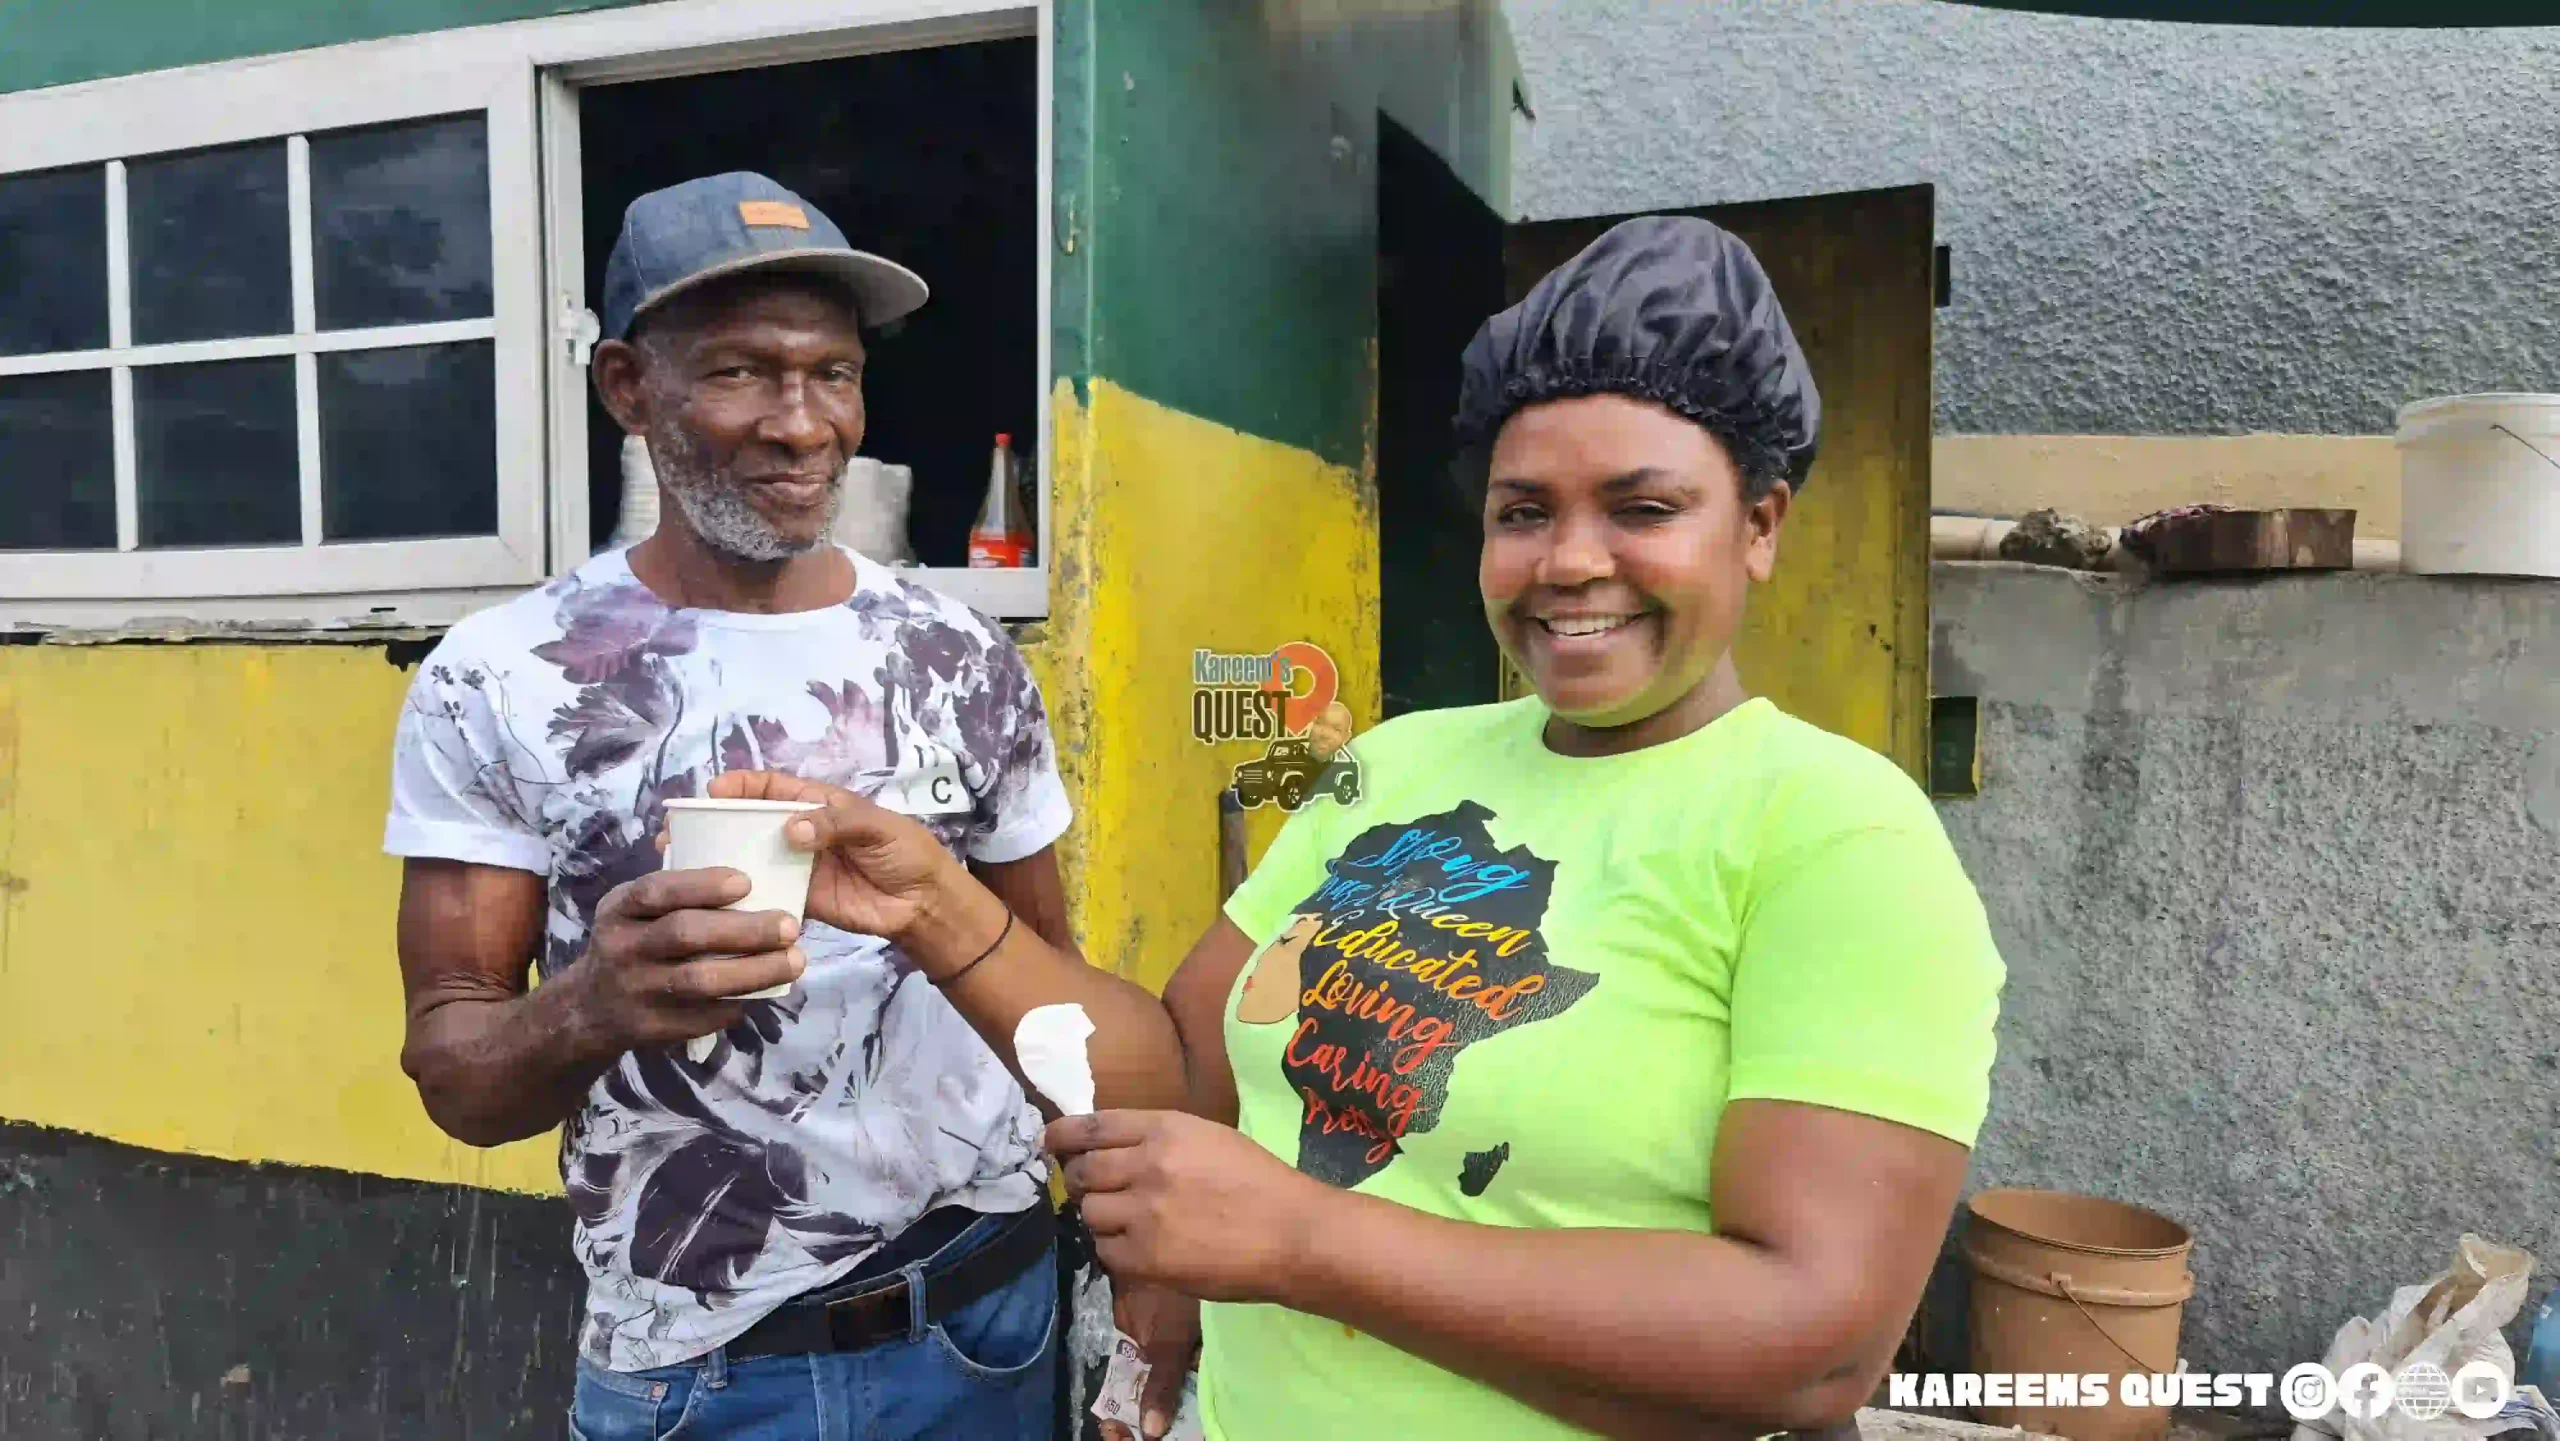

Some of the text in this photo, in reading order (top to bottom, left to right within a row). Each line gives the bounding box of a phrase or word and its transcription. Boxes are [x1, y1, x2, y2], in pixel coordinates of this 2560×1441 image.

[1347, 828, 1531, 902] Strong
[1312, 908, 1546, 1021] Educated
[1376, 886, 1532, 958] Queen
[1301, 958, 1457, 1075] Loving
[1286, 1016, 1431, 1138] Caring
